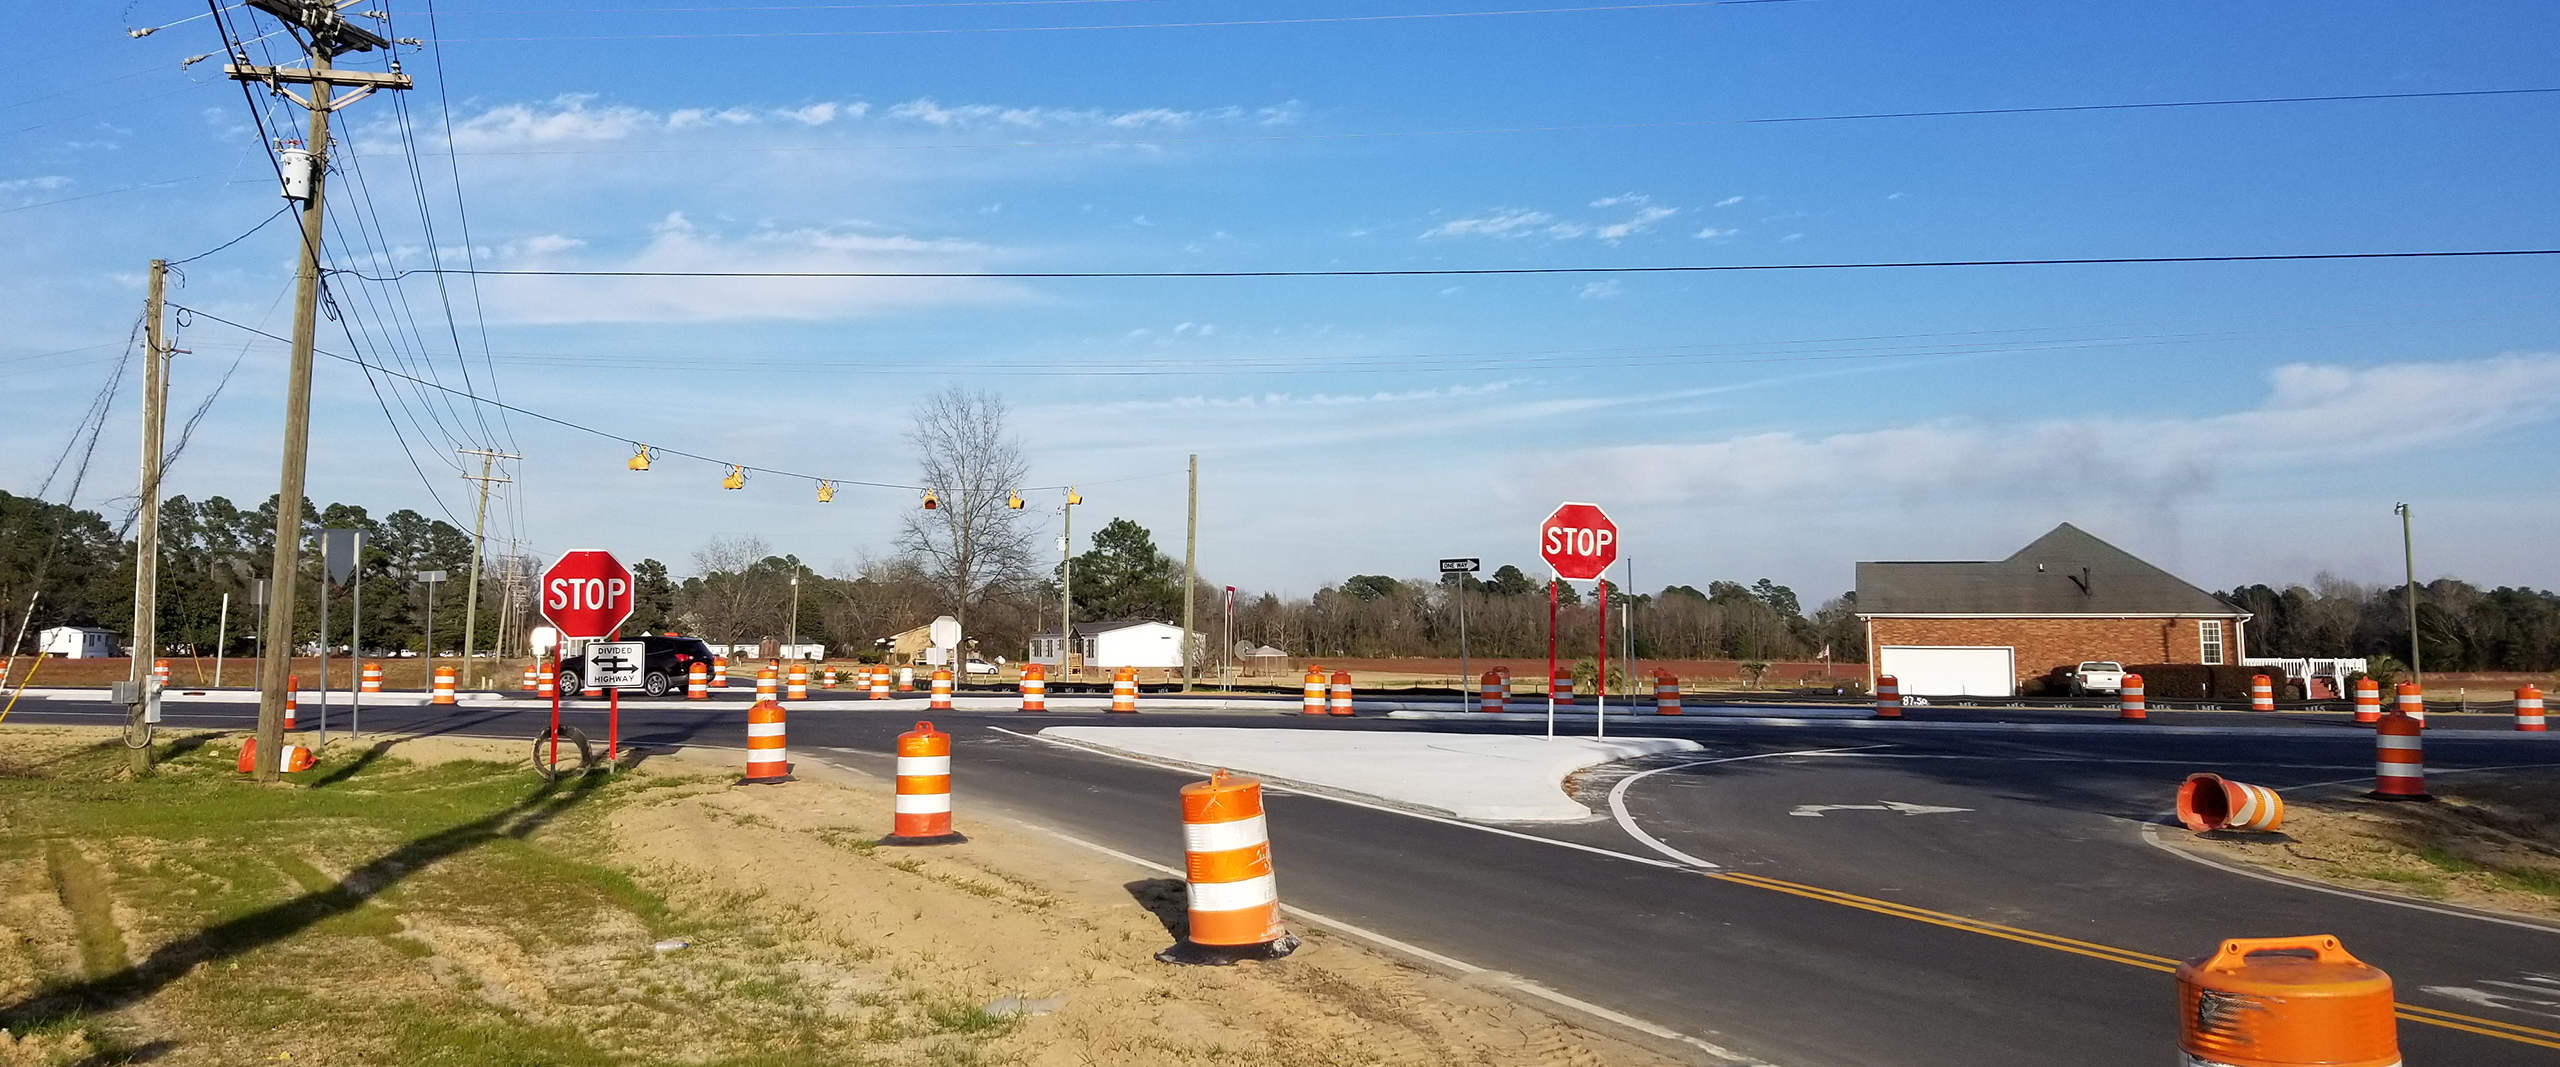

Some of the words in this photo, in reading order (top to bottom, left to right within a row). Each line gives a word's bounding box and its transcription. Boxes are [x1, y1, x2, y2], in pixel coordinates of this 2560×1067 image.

[1545, 526, 1613, 557] STOP
[549, 578, 626, 610] STOP
[598, 647, 632, 655] DIVIDED
[594, 675, 635, 683] HIGHWAY
[1902, 695, 1928, 706] 87.50
